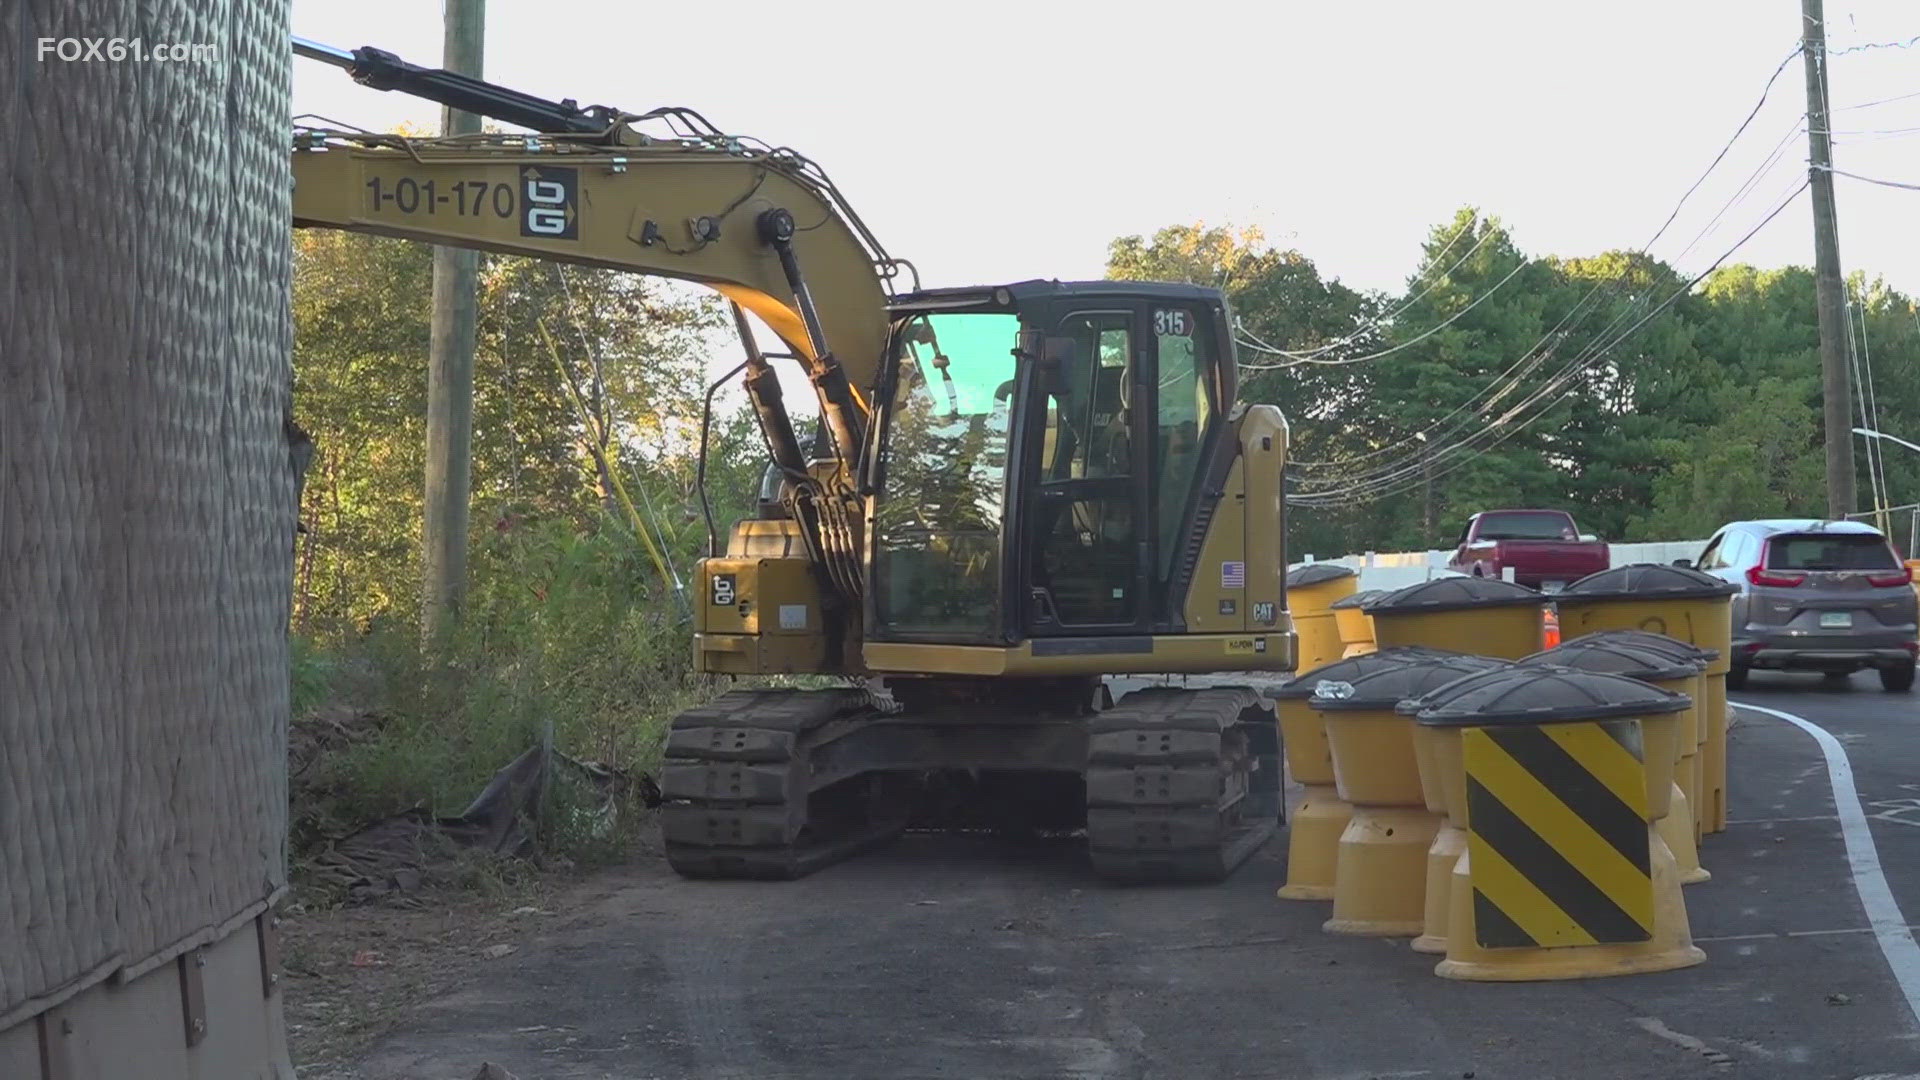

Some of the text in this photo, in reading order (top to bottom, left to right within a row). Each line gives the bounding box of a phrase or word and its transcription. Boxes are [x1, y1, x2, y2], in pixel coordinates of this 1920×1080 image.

[366, 176, 515, 219] 1-01-170
[1155, 310, 1184, 334] 315
[1253, 603, 1273, 621] CAT
